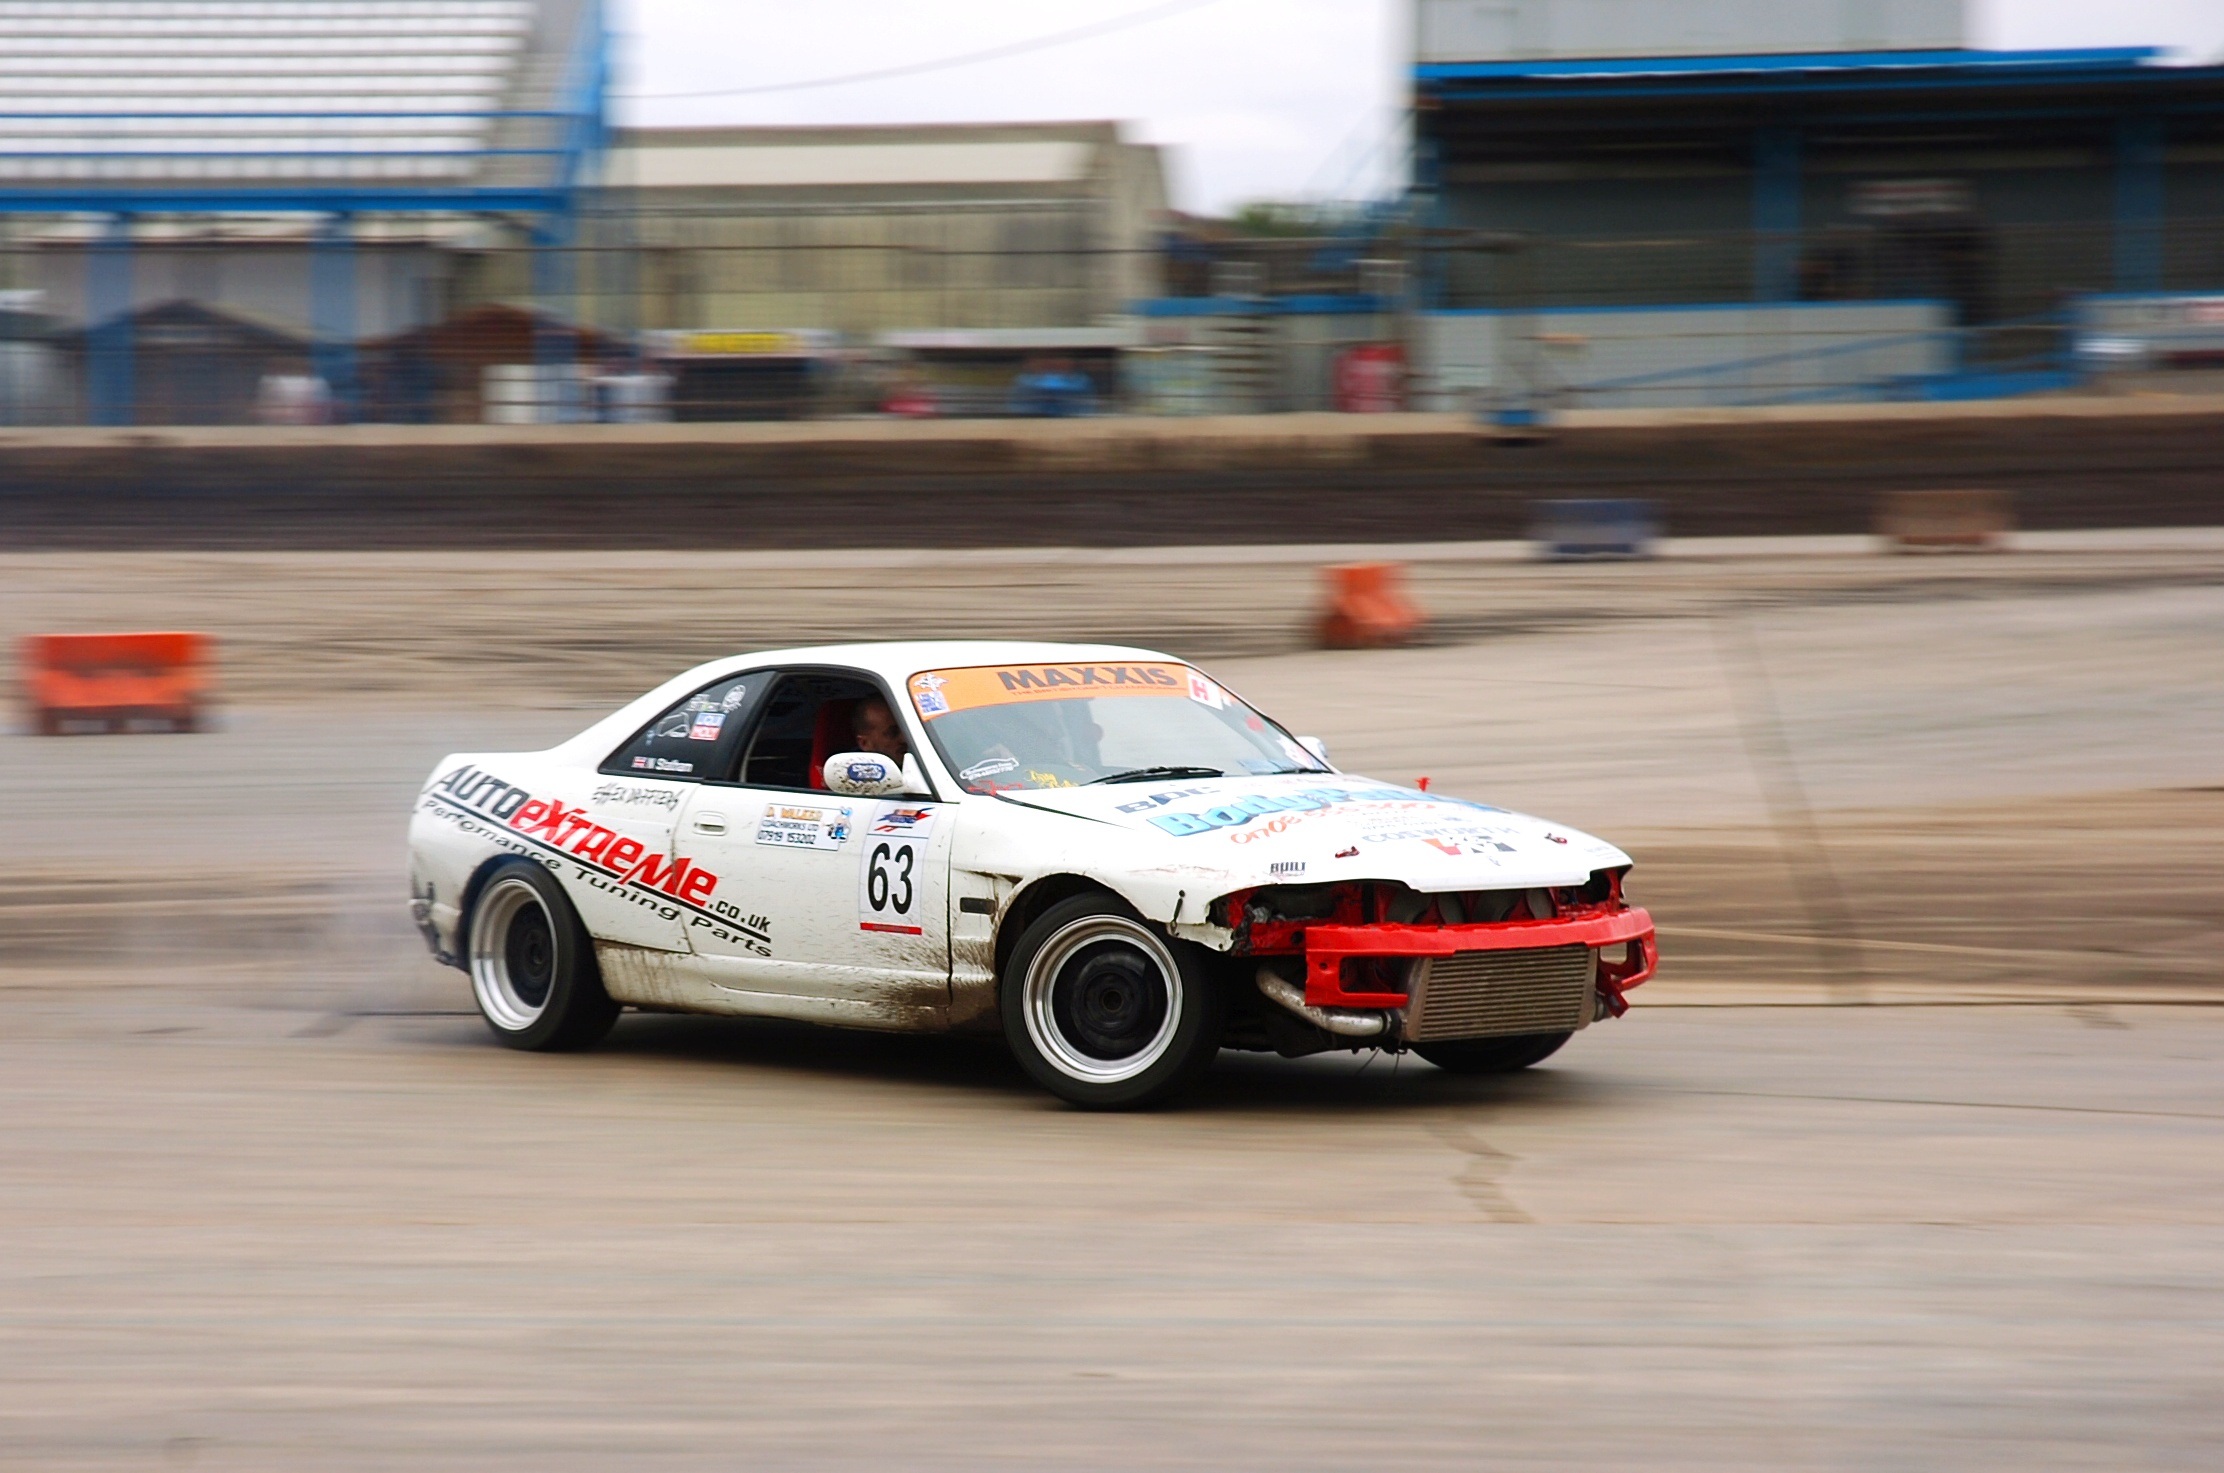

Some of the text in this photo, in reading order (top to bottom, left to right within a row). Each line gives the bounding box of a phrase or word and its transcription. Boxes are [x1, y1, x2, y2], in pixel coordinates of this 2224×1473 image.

[997, 666, 1178, 691] MAXXIS
[574, 866, 681, 921] Tuning
[691, 916, 772, 958] Parts
[867, 842, 914, 915] 63
